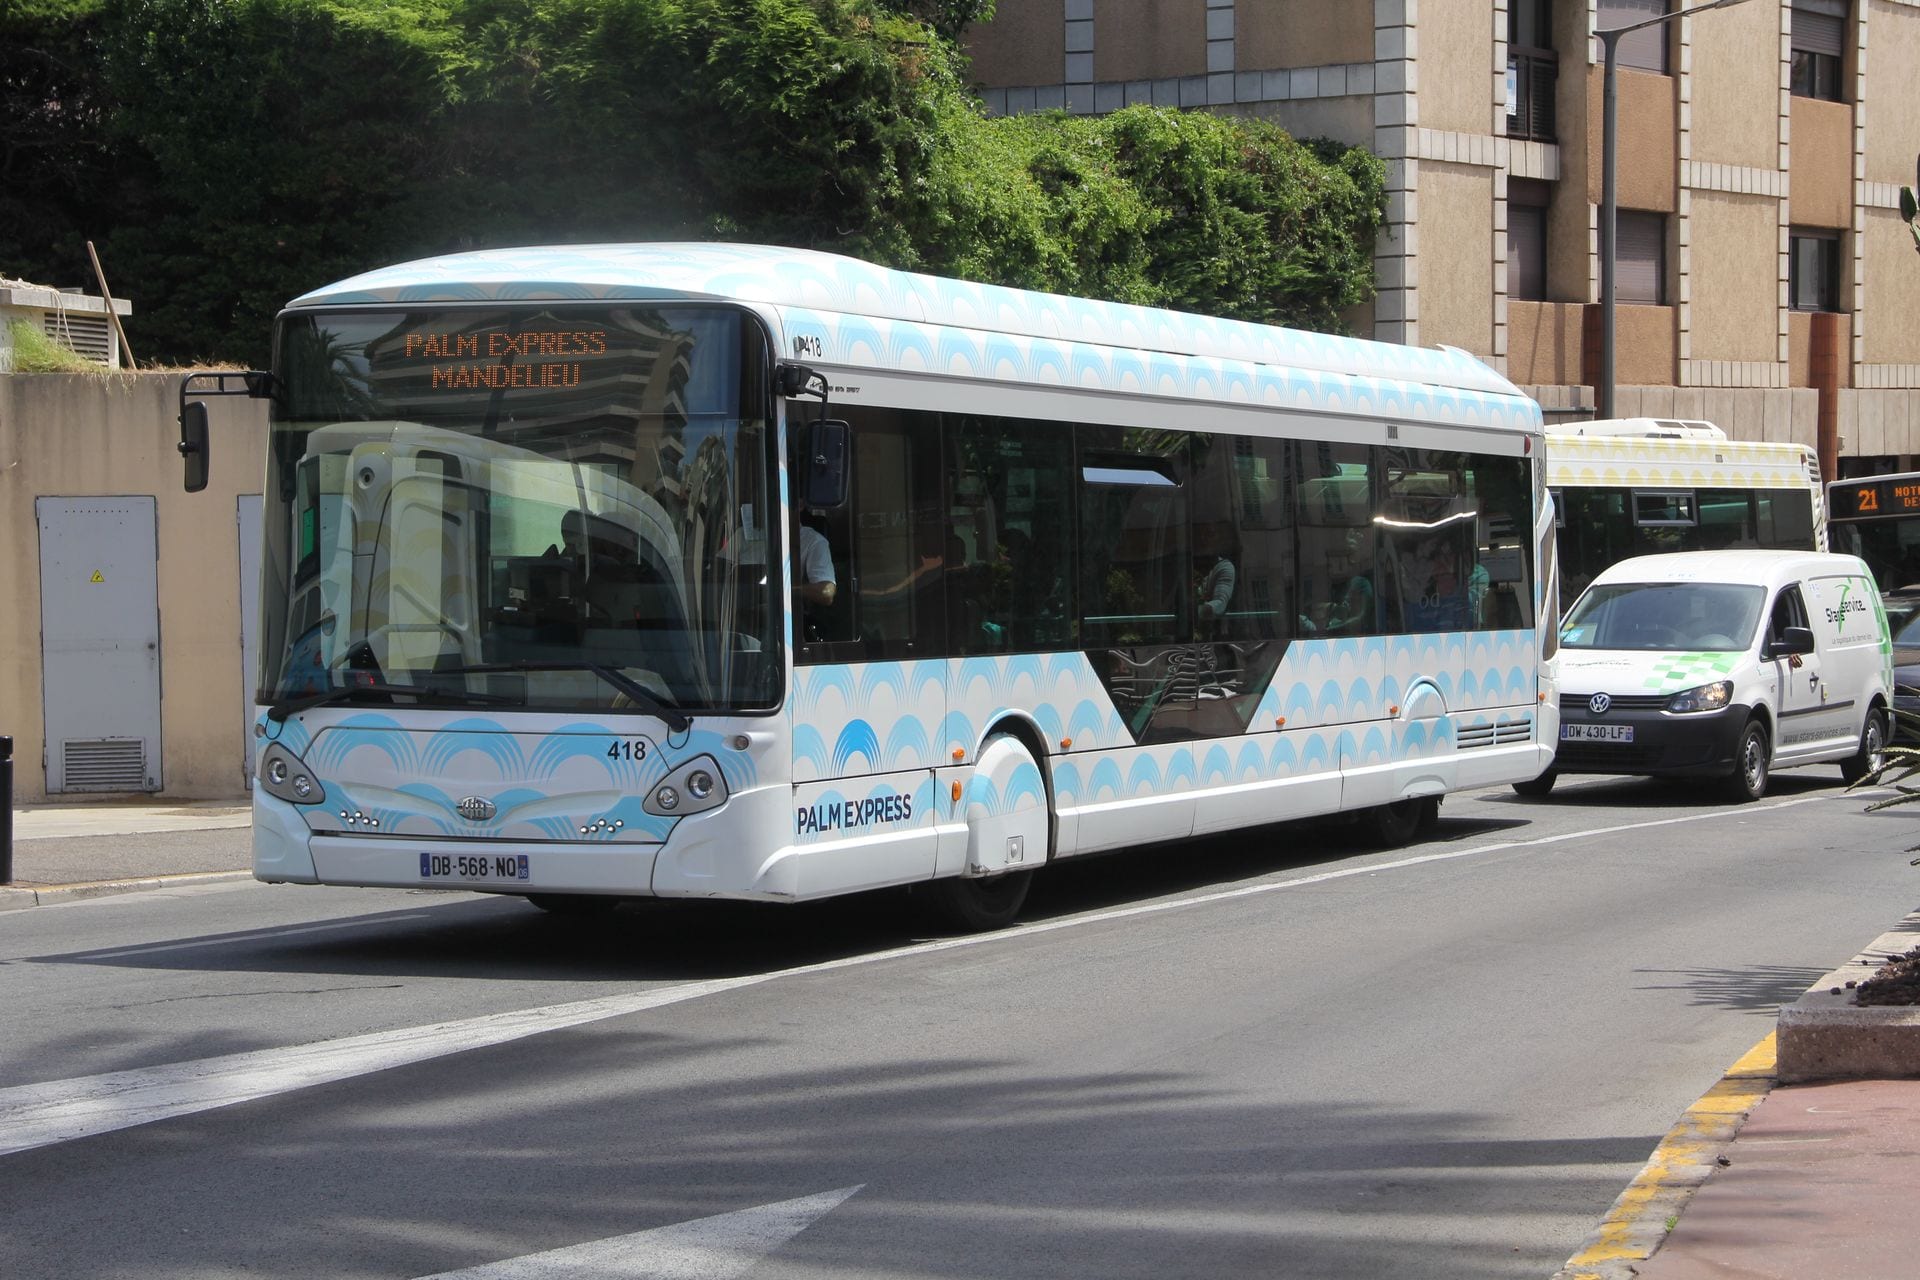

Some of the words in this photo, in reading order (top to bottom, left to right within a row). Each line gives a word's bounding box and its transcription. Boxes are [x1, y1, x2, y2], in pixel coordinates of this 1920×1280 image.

[405, 333, 478, 357] PALM
[488, 331, 606, 356] EXPRESS
[431, 364, 582, 388] MANDELIEU
[1858, 489, 1879, 511] 21
[1904, 497, 1920, 508] DE
[1568, 725, 1625, 739] DW-430-LF
[607, 741, 646, 761] 418
[798, 802, 841, 834] PALM
[844, 794, 911, 828] EXPRESS
[432, 856, 516, 877] DB-568-NQ
